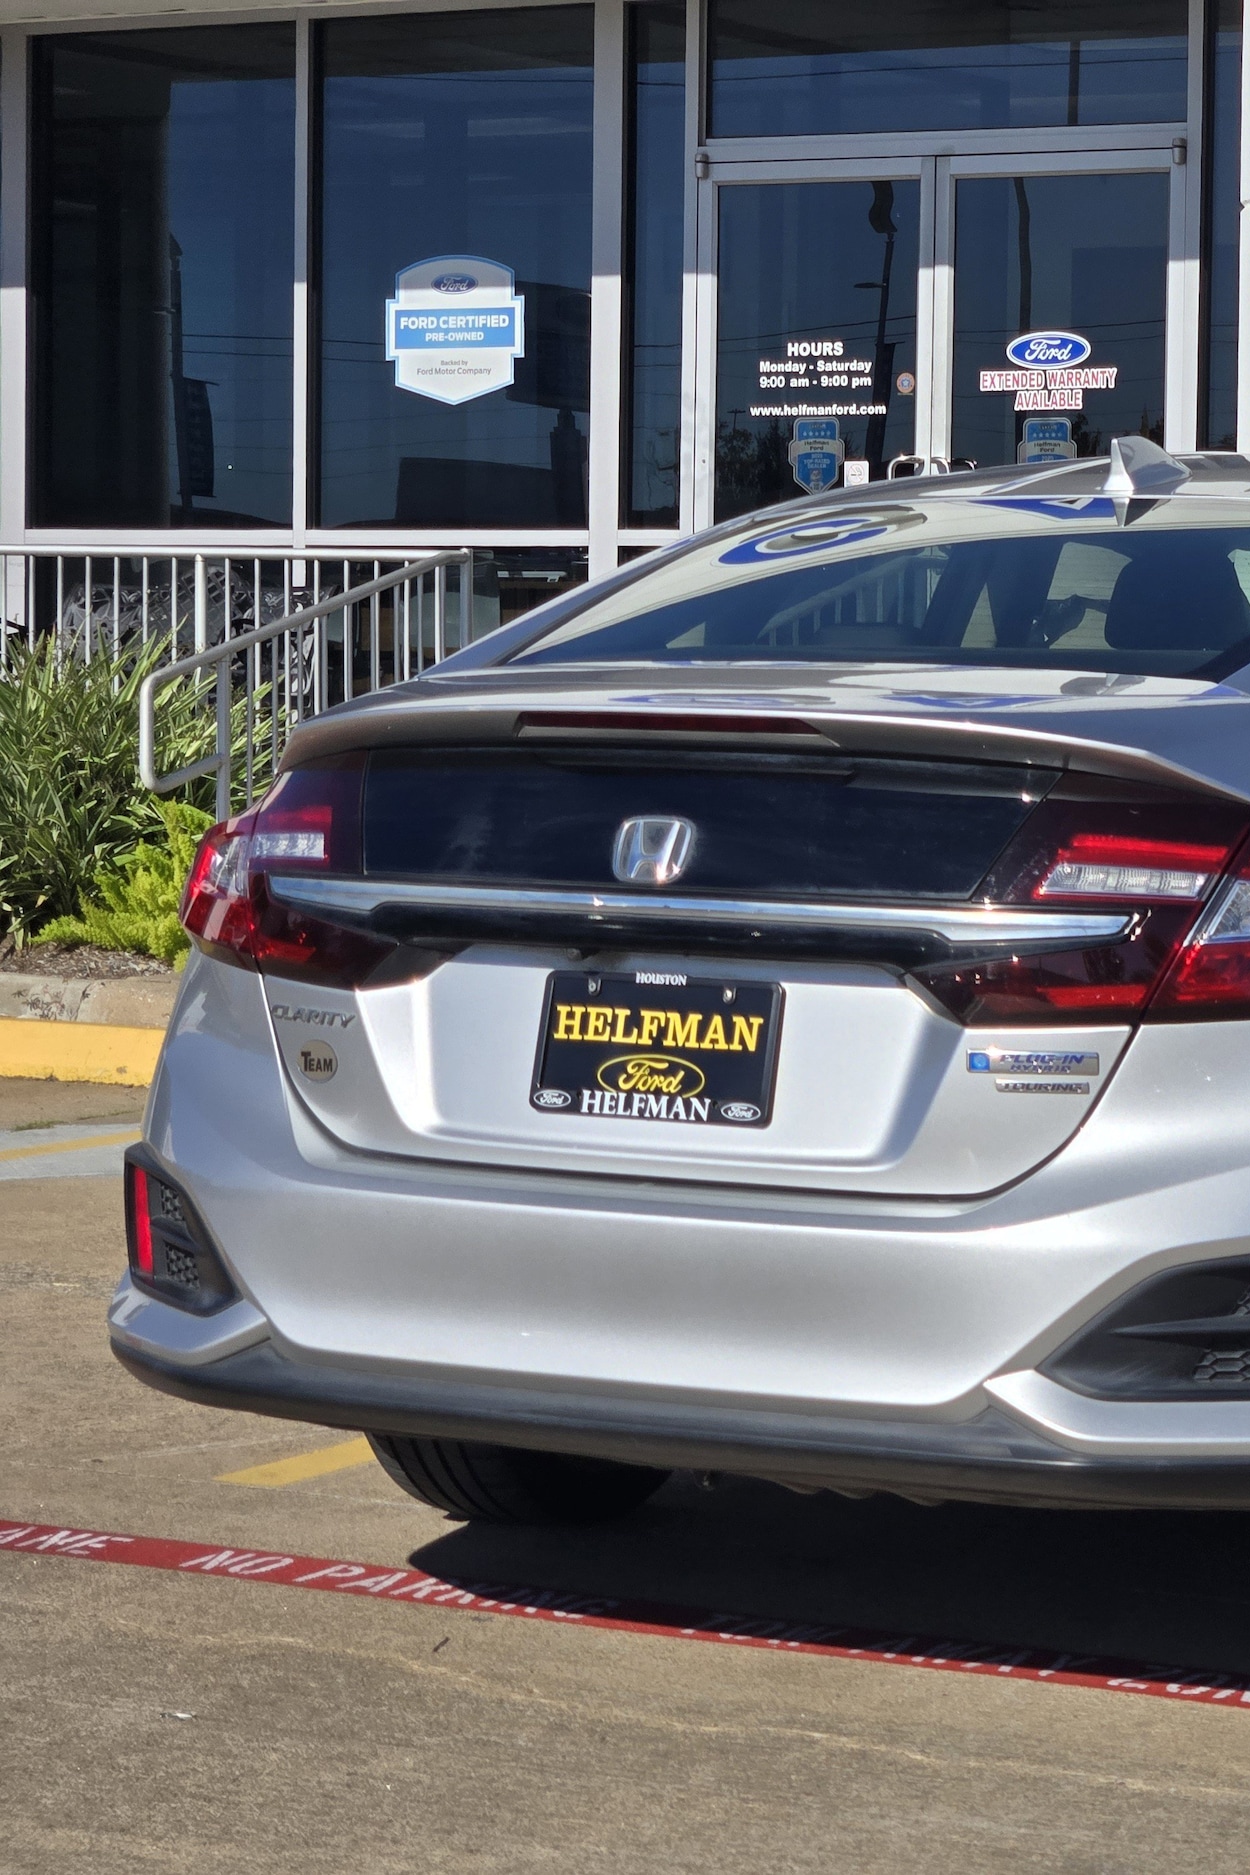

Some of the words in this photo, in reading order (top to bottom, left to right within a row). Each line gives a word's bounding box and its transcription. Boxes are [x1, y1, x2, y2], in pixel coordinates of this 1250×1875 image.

[440, 276, 469, 291] Ford
[400, 317, 437, 329] FORD
[439, 315, 509, 328] CERTIFIED
[425, 332, 484, 342] PRE-OWNED
[787, 342, 844, 356] HOURS
[1024, 338, 1073, 361] Ford
[417, 368, 433, 376] Ford
[434, 367, 456, 375] Motor
[457, 367, 491, 376] Company
[759, 361, 806, 374] Monday
[816, 360, 872, 373] Saturday
[759, 376, 785, 388] 9:00
[790, 378, 809, 387] am
[820, 375, 848, 387] 9:00
[851, 376, 872, 388] pm
[981, 371, 1044, 391] EXTENDED
[1048, 368, 1117, 389] WARRANTY
[1014, 389, 1083, 411] AVAILABLE
[750, 404, 886, 417] www.helfmanford.com
[635, 972, 687, 986] HOUSTON
[271, 1004, 356, 1029] CLARITY
[553, 1004, 764, 1052] HELFMAN
[1000, 1054, 1084, 1065] PLUG-IN
[1010, 1064, 1072, 1074] HYBRID
[618, 1059, 685, 1094] Ford
[1001, 1082, 1083, 1093] TOURING
[539, 1092, 565, 1106] Ford
[581, 1089, 711, 1122] HELFMAN
[727, 1104, 754, 1119] Ford
[0, 1526, 132, 1555] ANE
[179, 1550, 295, 1575] NO
